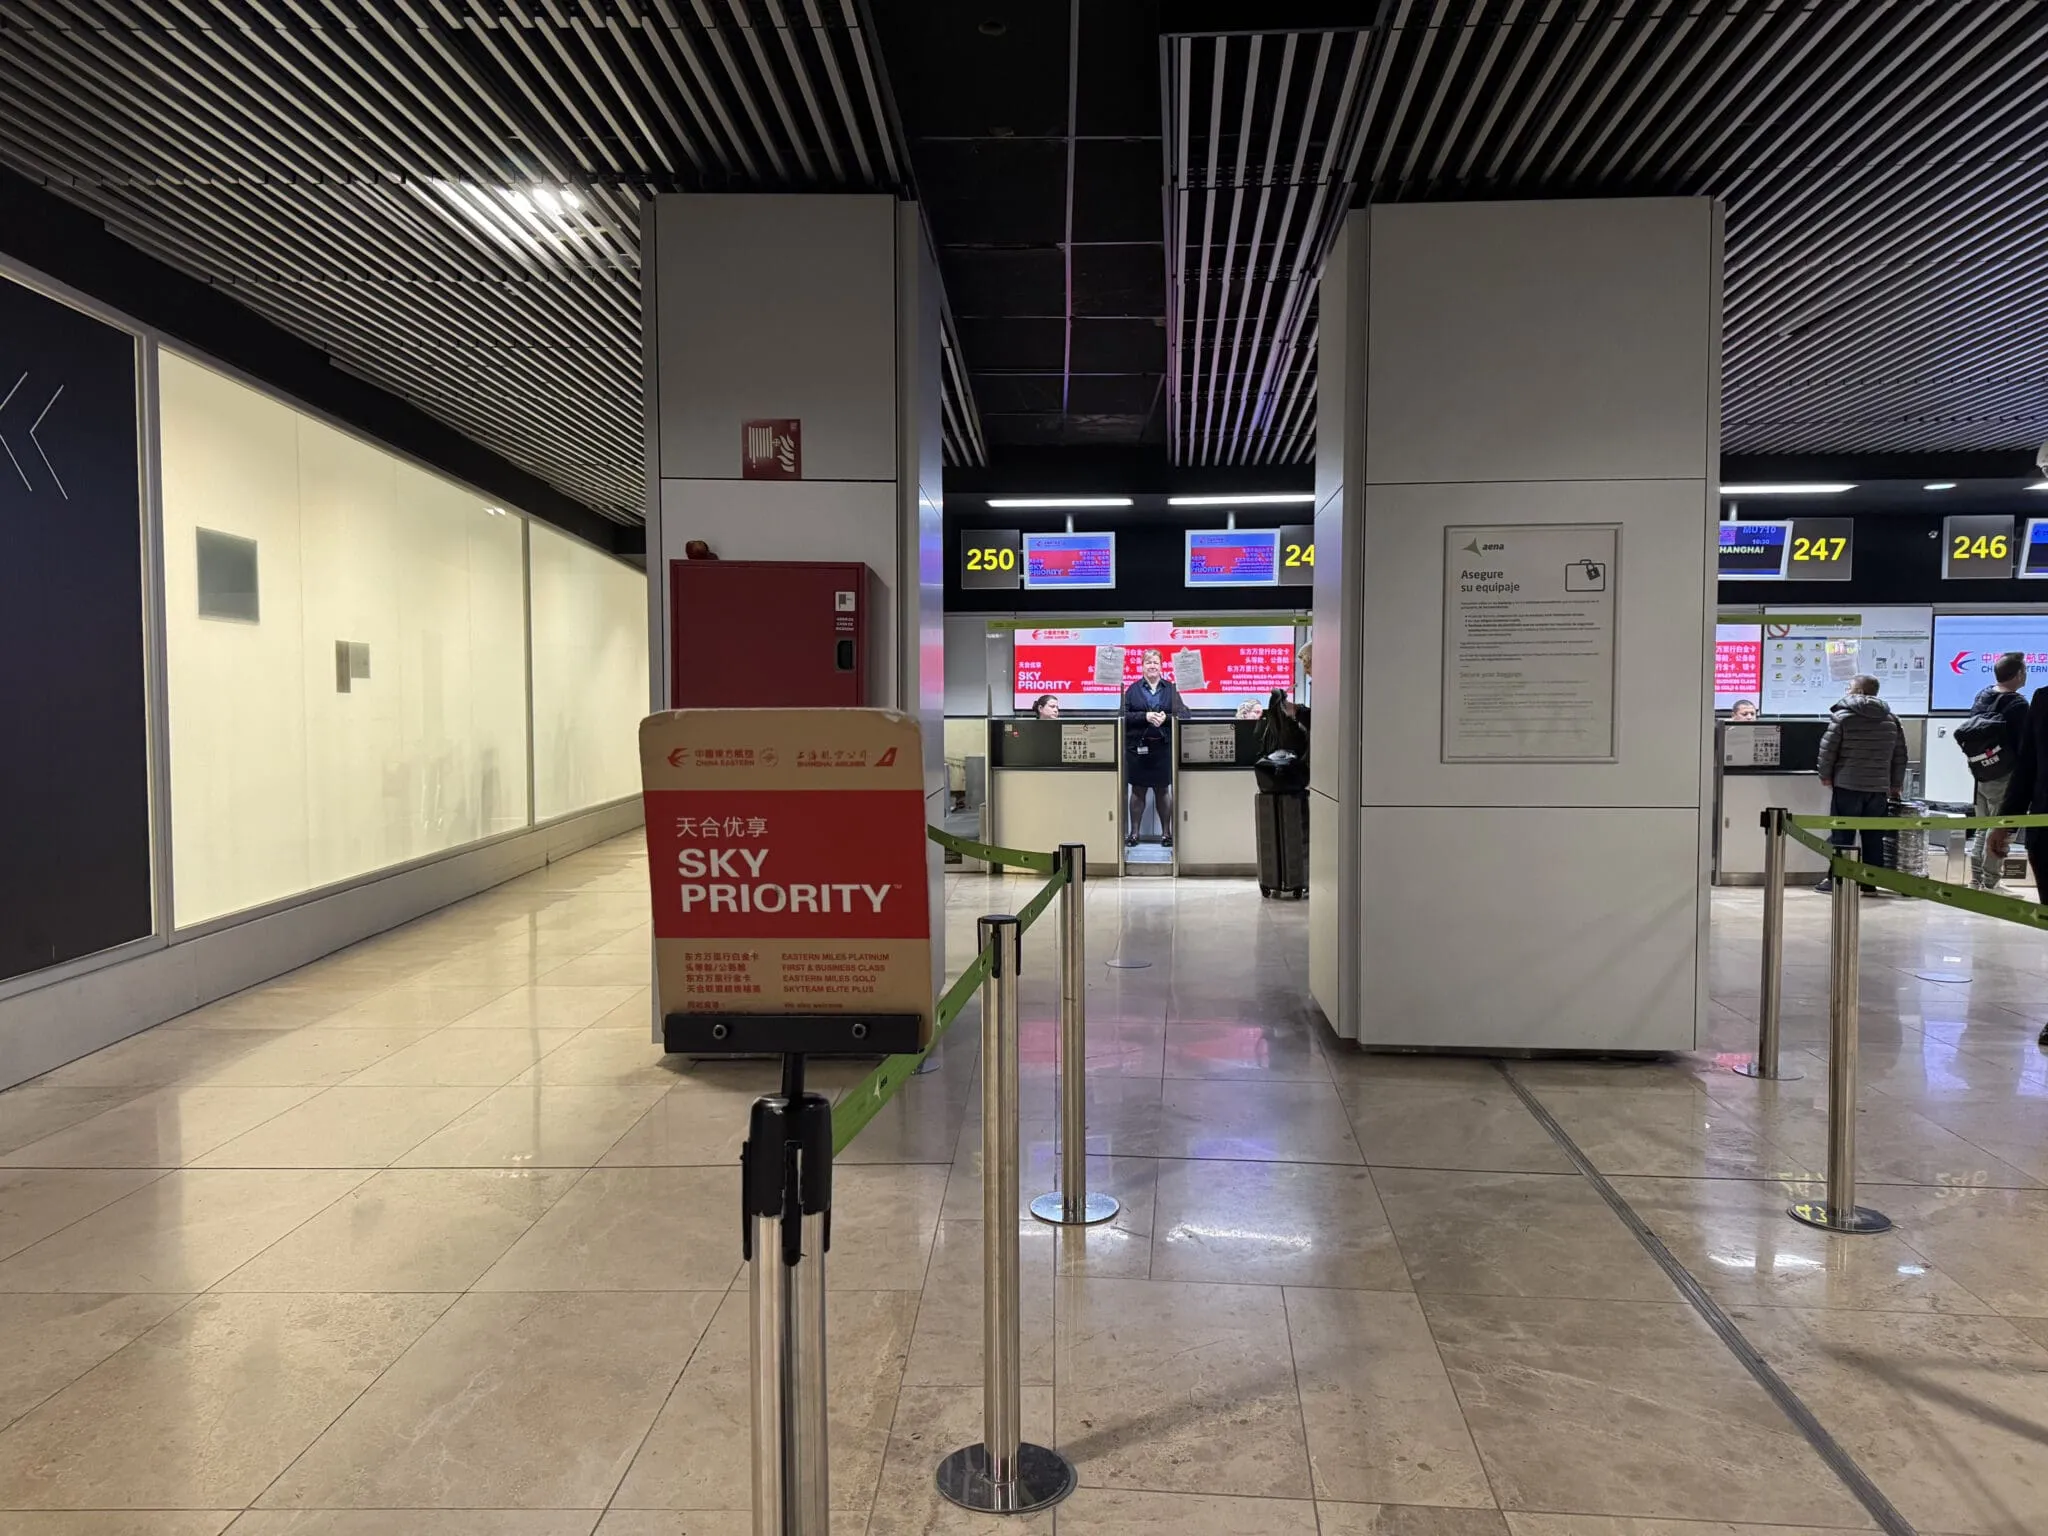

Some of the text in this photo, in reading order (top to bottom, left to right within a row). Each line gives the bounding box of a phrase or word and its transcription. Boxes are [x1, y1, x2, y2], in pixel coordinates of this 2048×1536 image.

[1482, 543, 1504, 551] aena
[1719, 546, 1764, 554] HANGHAI
[1794, 538, 1846, 560] 247
[1953, 535, 2008, 559] 246
[967, 548, 1014, 570] 250
[1285, 544, 1314, 566] 24
[1461, 570, 1504, 581] Asegure
[1460, 582, 1520, 594] su equipaje
[1018, 671, 1042, 680] SKY
[1018, 680, 1072, 690] PRIORITY
[1981, 754, 2000, 766] CREW
[676, 816, 768, 838] 天合优享
[678, 848, 769, 878] SKY
[681, 884, 891, 912] PRIORITY
[782, 953, 890, 961] EASTERN MILES PLATINUM
